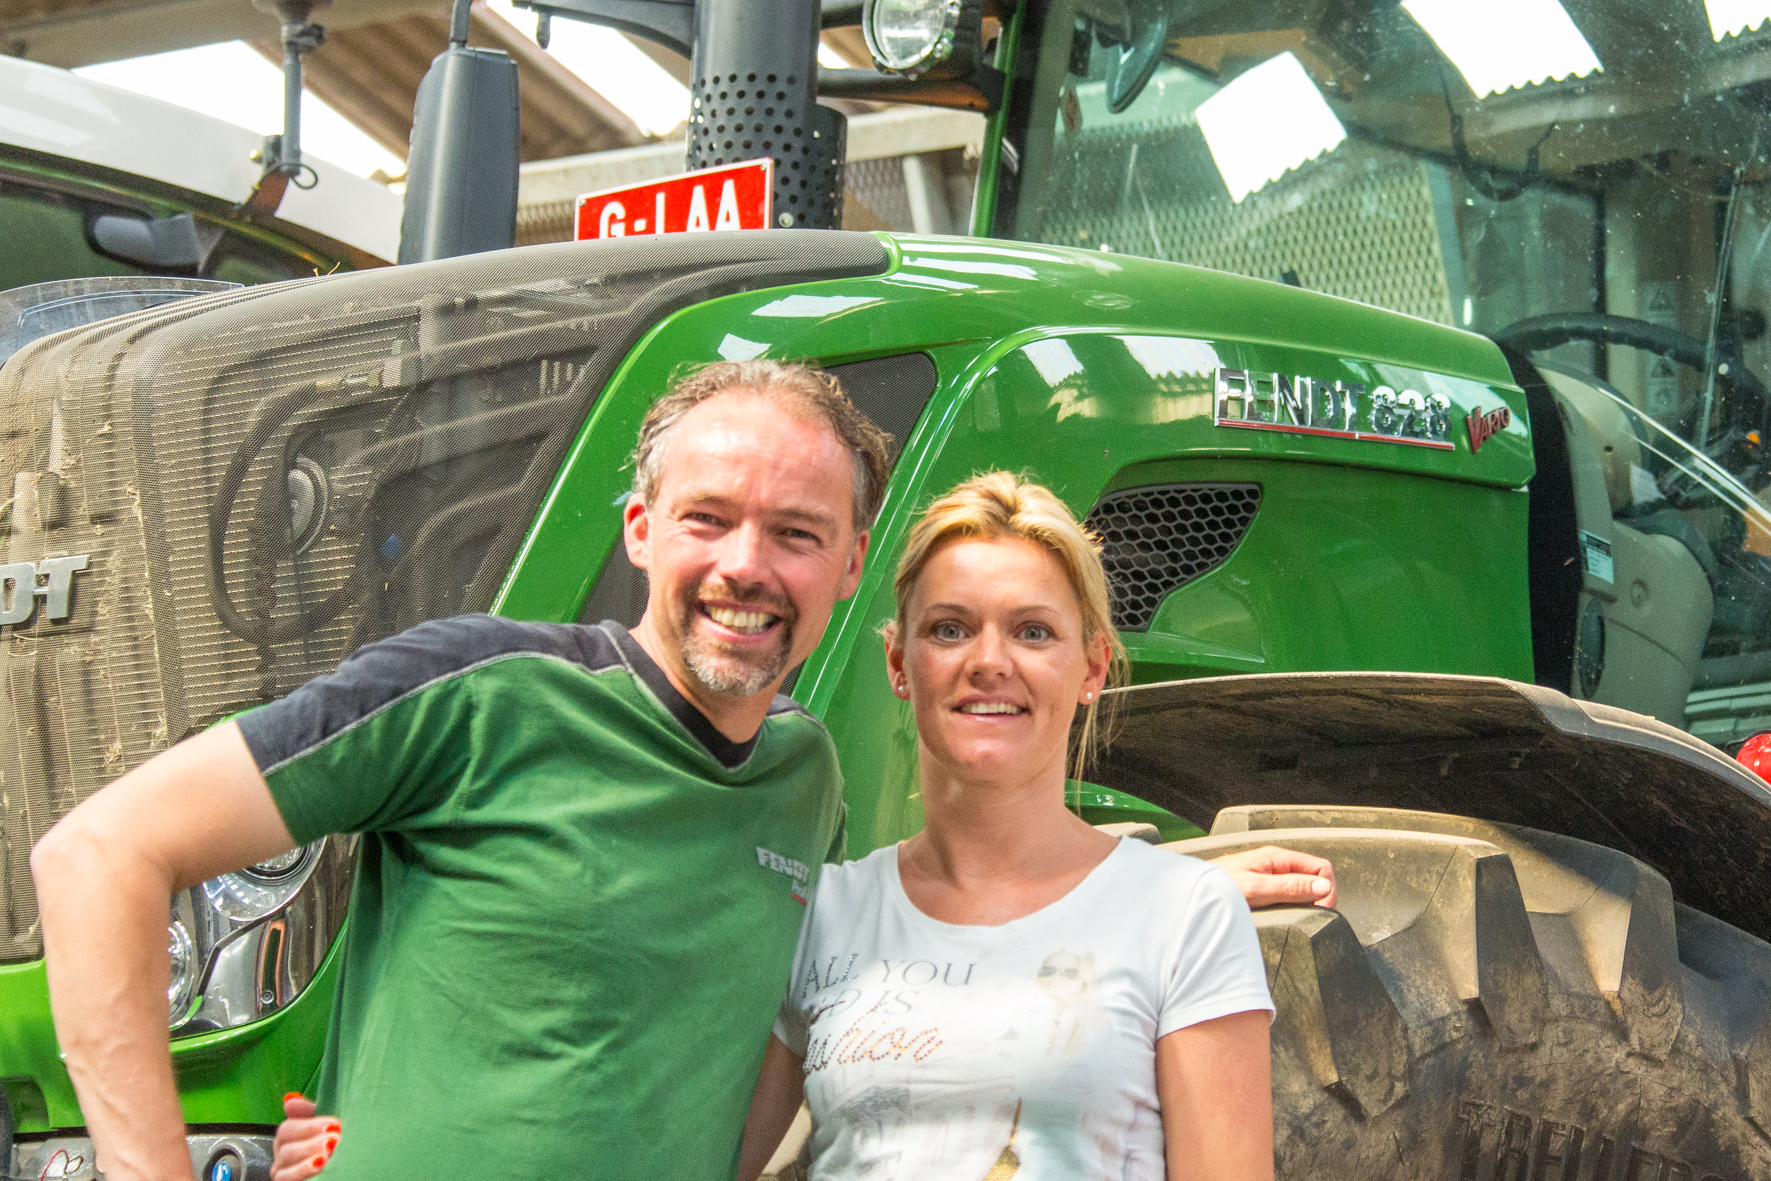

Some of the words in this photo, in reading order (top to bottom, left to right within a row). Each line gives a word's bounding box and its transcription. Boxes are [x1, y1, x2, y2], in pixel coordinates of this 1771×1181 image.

[1214, 367, 1366, 431] FENDT
[1369, 385, 1453, 441] 828
[802, 953, 859, 999] ALL
[881, 959, 977, 987] YOU
[873, 989, 920, 1016] IS
